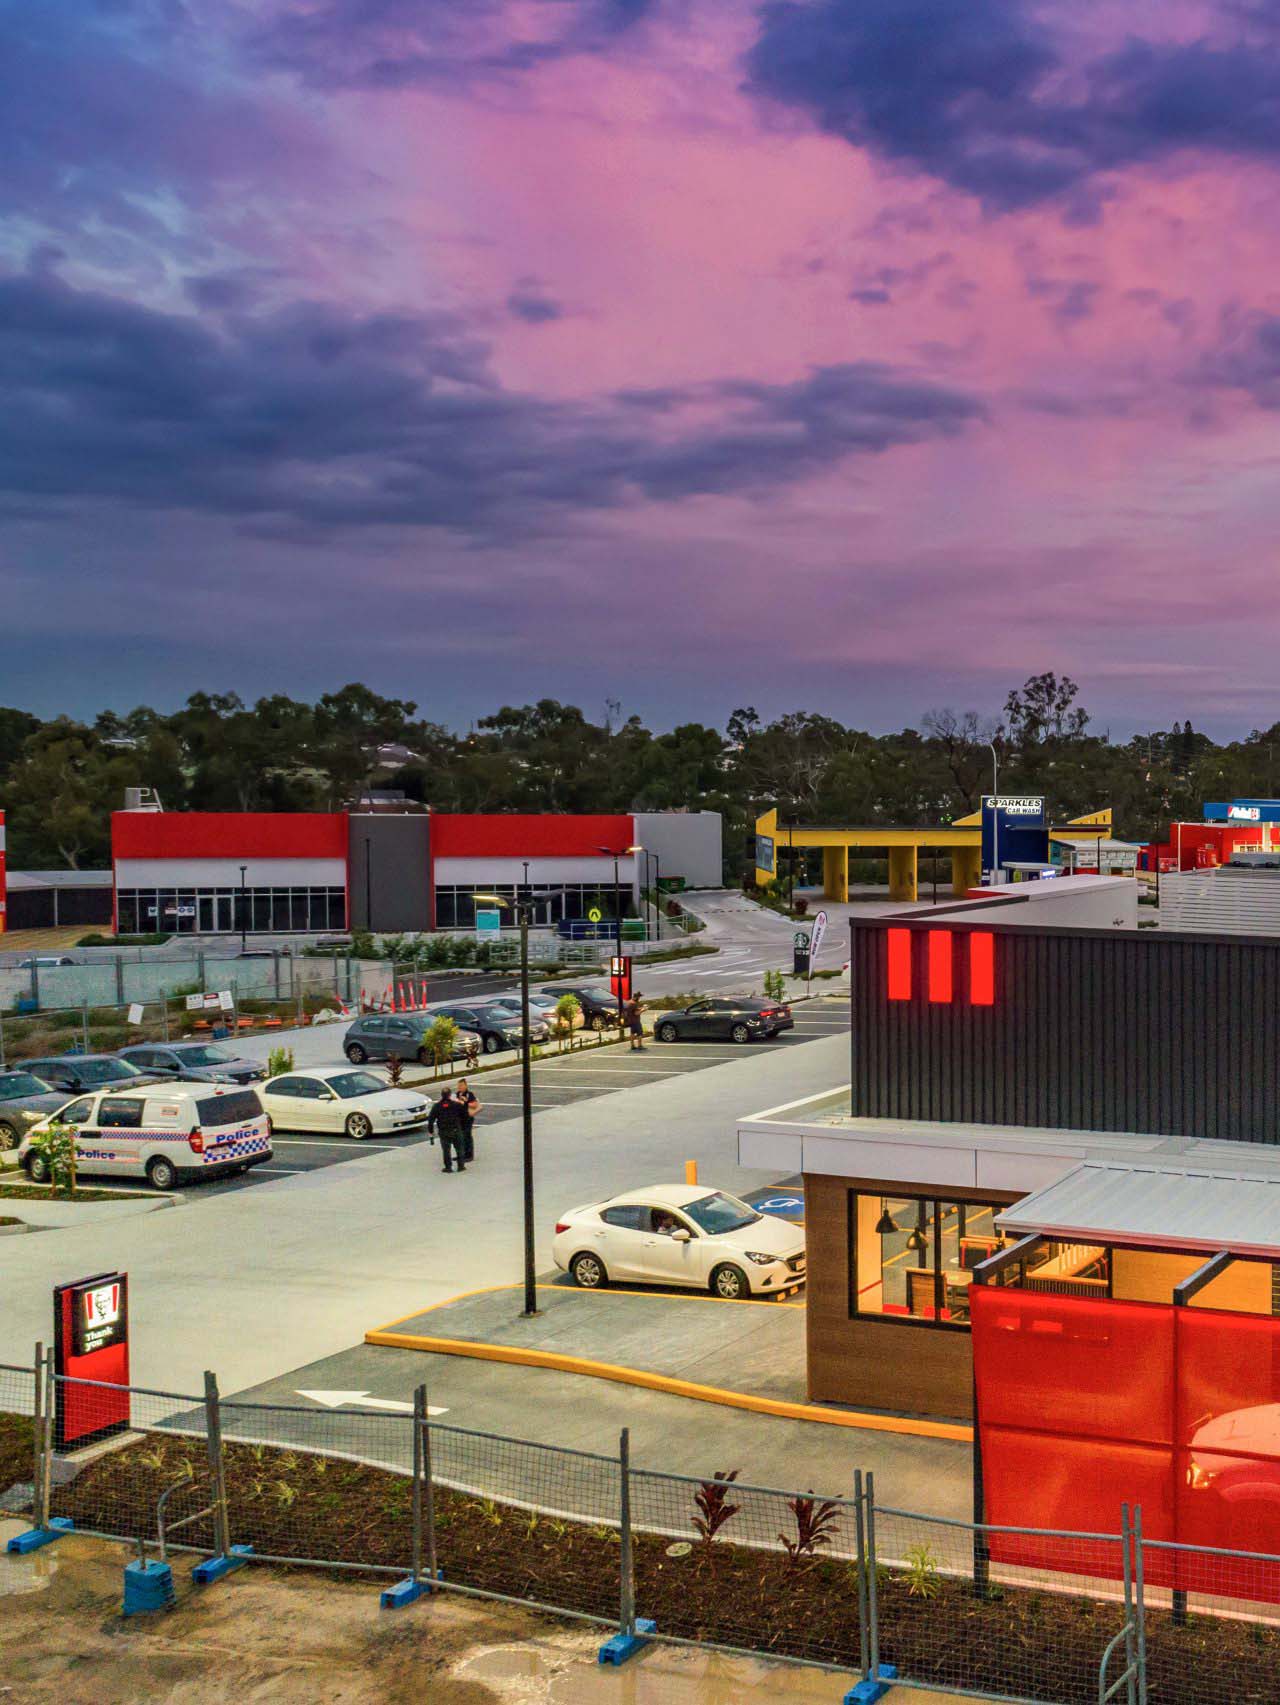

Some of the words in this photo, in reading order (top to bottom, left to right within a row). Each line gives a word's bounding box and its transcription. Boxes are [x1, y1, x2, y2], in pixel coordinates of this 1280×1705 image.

[988, 799, 1041, 807] SPARKLES
[216, 1127, 259, 1143] Police
[77, 1149, 116, 1160] Police
[85, 1326, 113, 1341] Thank
[85, 1338, 103, 1352] you
